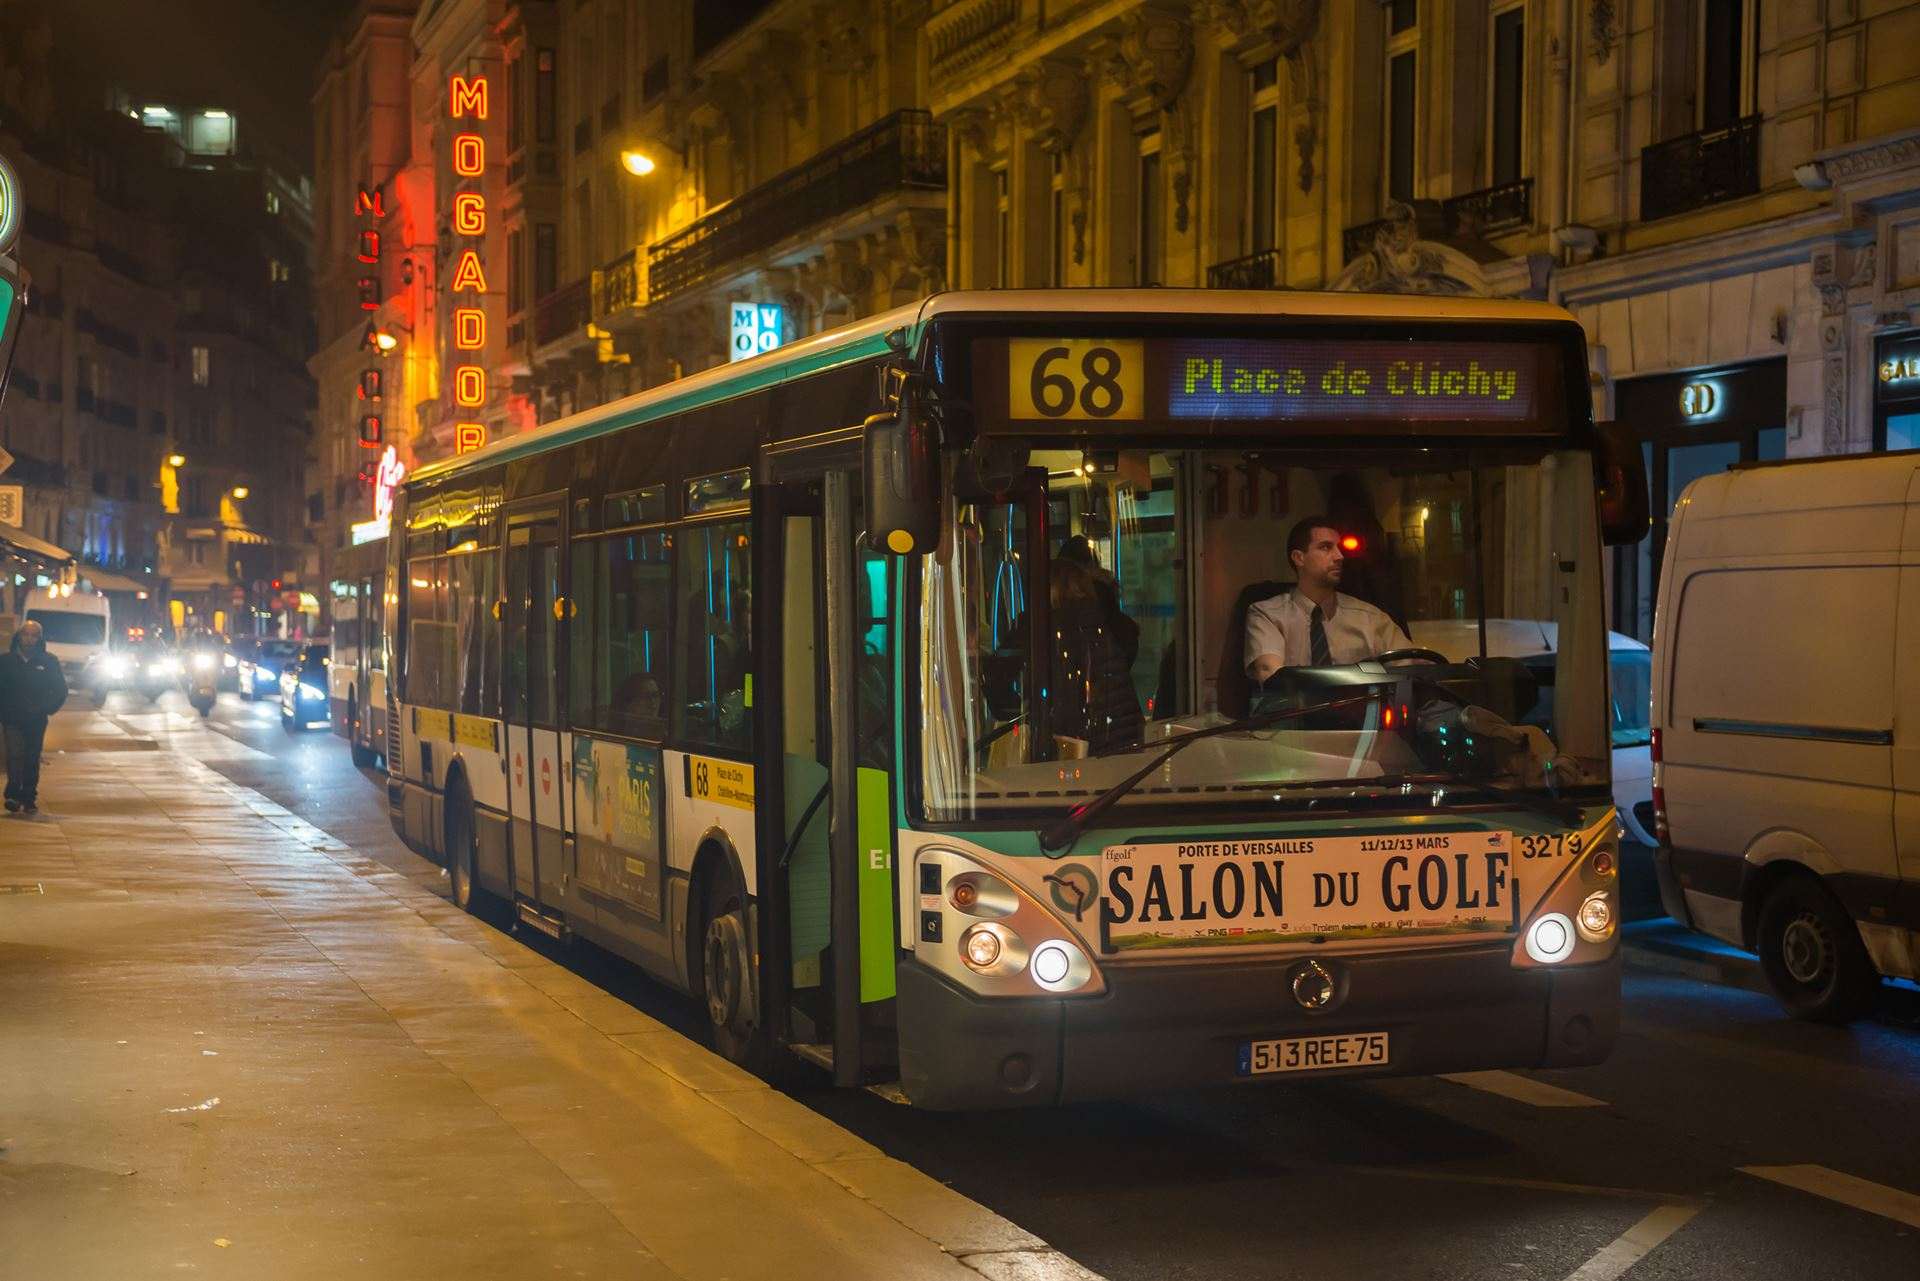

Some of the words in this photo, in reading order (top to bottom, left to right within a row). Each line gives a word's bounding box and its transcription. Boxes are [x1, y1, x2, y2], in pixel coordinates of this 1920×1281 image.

[450, 75, 489, 455] MOGADOR
[1030, 346, 1124, 418] 68
[1184, 357, 1307, 395] Place
[1321, 360, 1371, 396] de
[1386, 359, 1518, 401] Clichy
[696, 761, 709, 797] 68
[1106, 848, 1131, 862] ffgolf
[1178, 844, 1219, 858] PORTE
[1222, 843, 1239, 857] DE
[1241, 841, 1314, 855] VERSAILLES
[1361, 838, 1414, 852] 11/12/13
[1416, 836, 1450, 850] MARS
[1521, 833, 1582, 859] 3279
[1108, 860, 1285, 924] SALON
[1313, 872, 1360, 908] DU
[1381, 852, 1509, 912] GOLF
